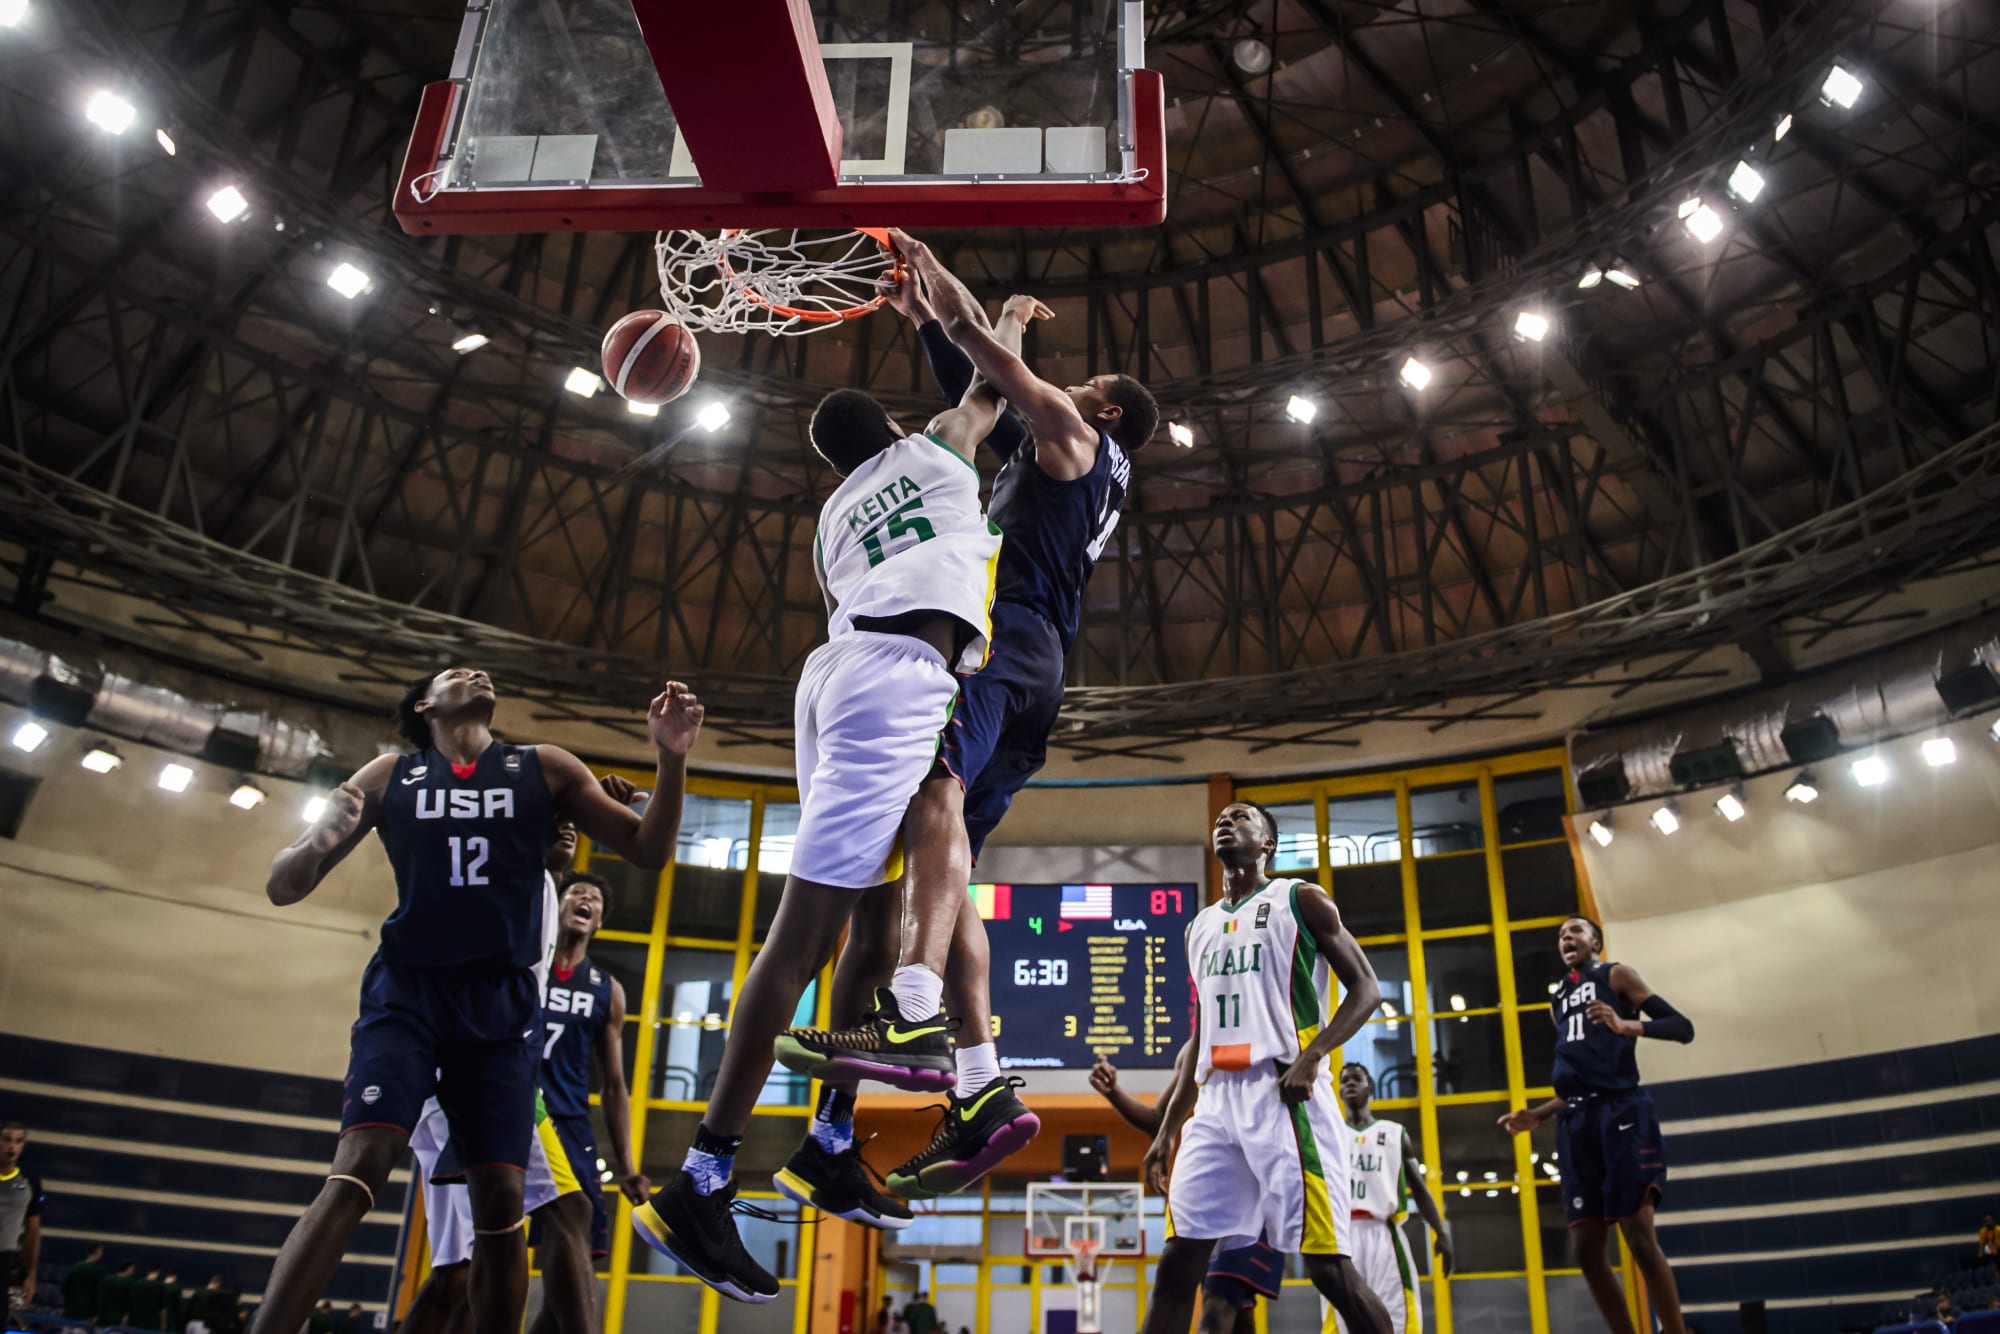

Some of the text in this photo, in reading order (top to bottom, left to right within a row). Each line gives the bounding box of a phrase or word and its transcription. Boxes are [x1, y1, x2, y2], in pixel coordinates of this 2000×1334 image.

[847, 475, 921, 534] KEITA
[858, 496, 936, 569] 15
[416, 788, 514, 819] USA
[448, 836, 490, 886] 12
[1150, 889, 1183, 915] 87
[1028, 916, 1043, 936] 4
[1113, 918, 1148, 932] USA
[1014, 959, 1069, 986] 6:30
[1202, 943, 1262, 980] MALI
[541, 986, 595, 1018] SA
[1216, 993, 1241, 1029] 11
[543, 1022, 565, 1060] 7
[1063, 1015, 1078, 1037] 3
[1566, 1012, 1585, 1042] 11
